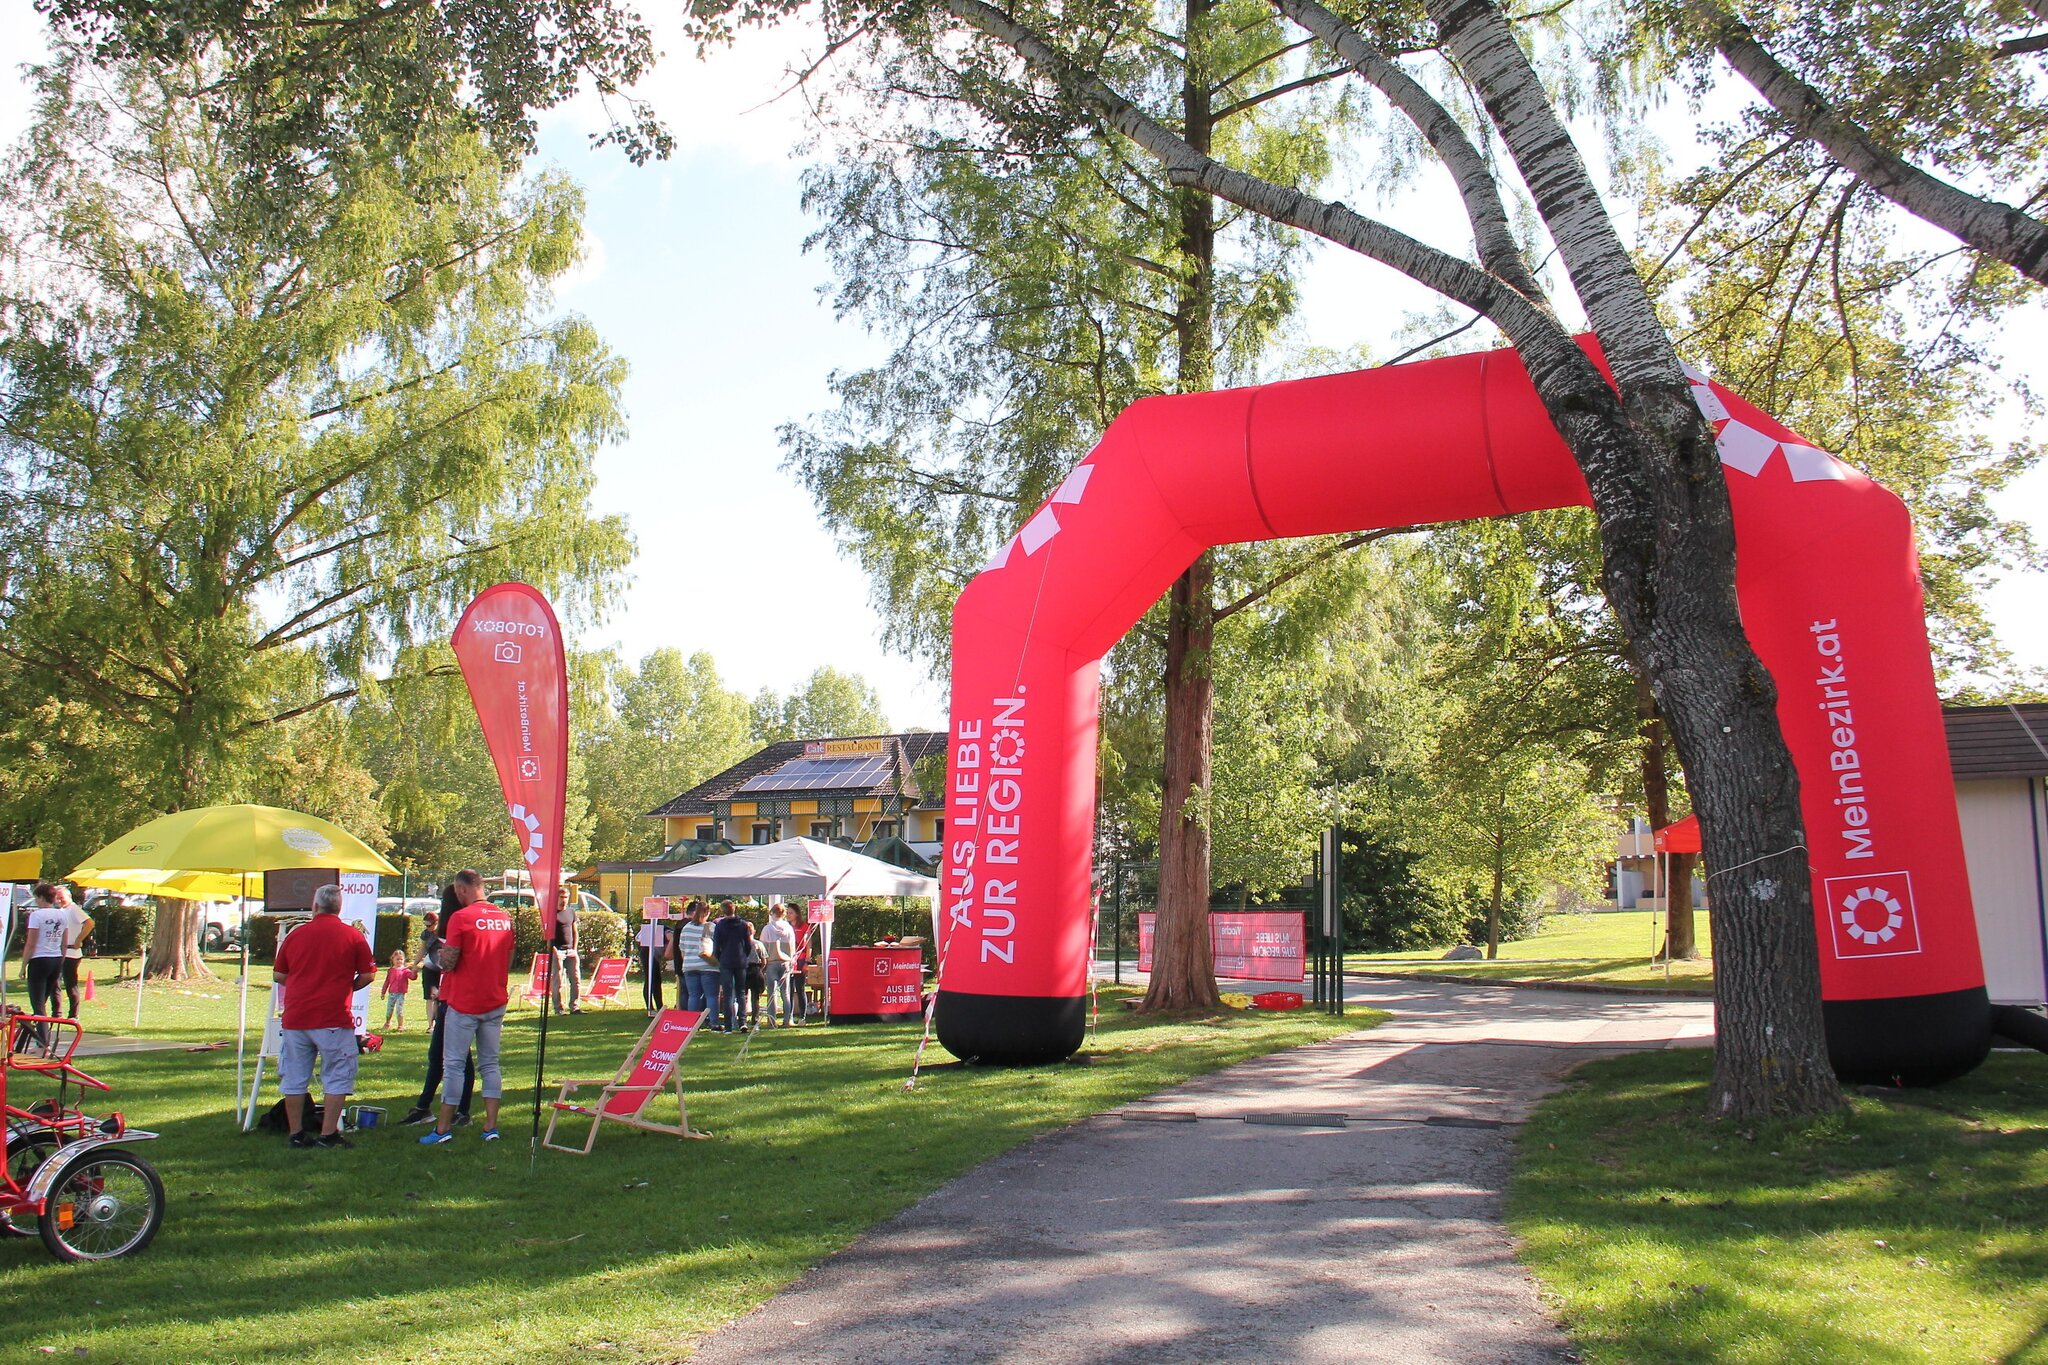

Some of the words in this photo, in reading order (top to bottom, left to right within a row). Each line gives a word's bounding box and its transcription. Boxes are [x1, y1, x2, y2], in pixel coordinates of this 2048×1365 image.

[1809, 618, 1874, 860] MeinBezirk.at
[826, 742, 880, 752] RESTAURANT
[954, 719, 982, 826] LIEBE
[985, 685, 1027, 864] REGION.
[340, 883, 374, 894] P-KI-DO
[950, 840, 977, 928] AUS
[475, 918, 511, 931] CREW
[980, 879, 1018, 964] ZUR
[886, 985, 902, 993] AUS
[881, 995, 897, 1003] ZUR
[651, 1049, 677, 1061] SONNE
[643, 1060, 669, 1072] PLATZ
